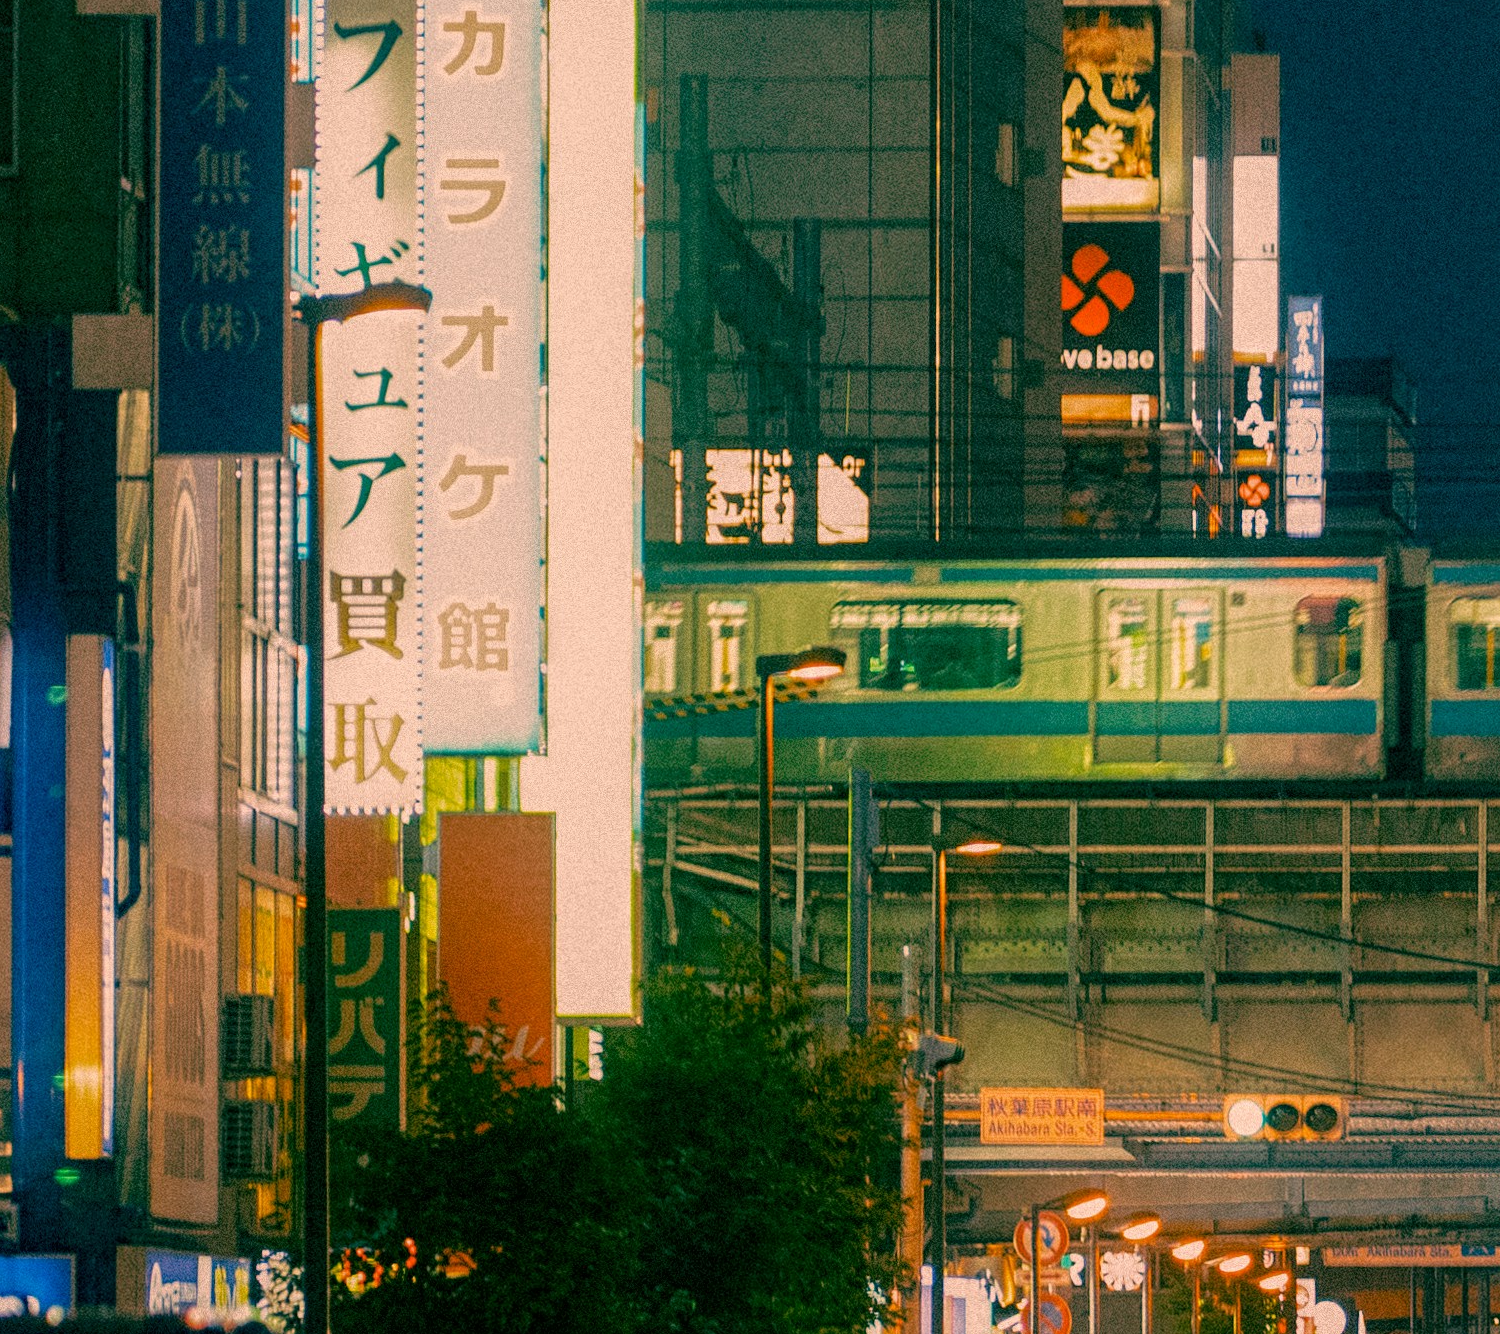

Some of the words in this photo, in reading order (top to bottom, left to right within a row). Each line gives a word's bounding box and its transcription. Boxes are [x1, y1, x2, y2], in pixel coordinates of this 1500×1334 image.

[440, 10, 510, 671] カラオケ館
[1097, 347, 1154, 370] base
[988, 1097, 1097, 1117] 秋葉原駅南
[989, 1120, 1049, 1135] Akihabara
